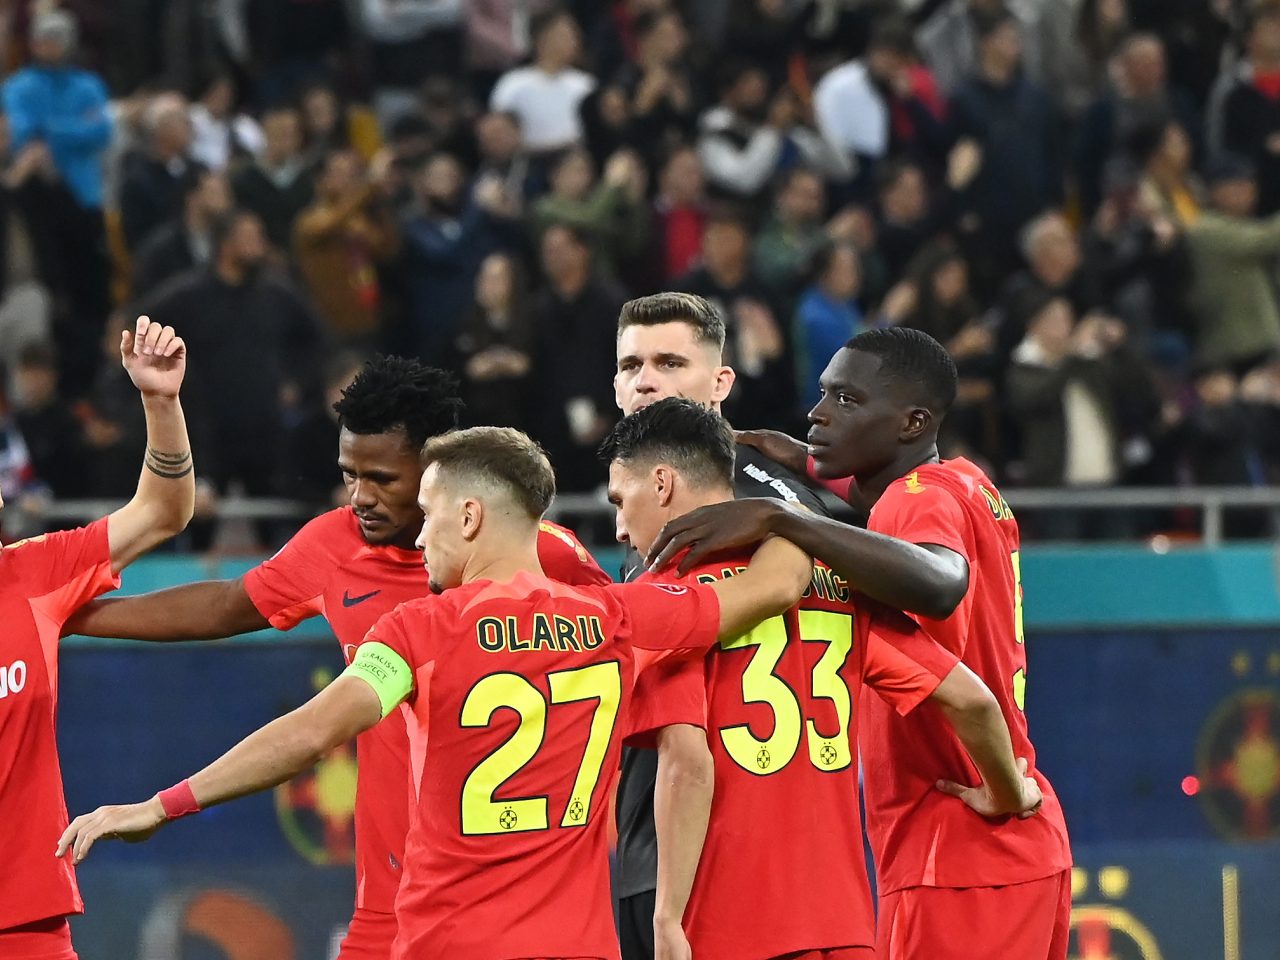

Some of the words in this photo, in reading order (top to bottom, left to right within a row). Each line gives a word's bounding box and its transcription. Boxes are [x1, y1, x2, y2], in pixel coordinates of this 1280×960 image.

[476, 613, 605, 652] OLARU
[720, 608, 854, 776] 33
[460, 660, 622, 836] 27
